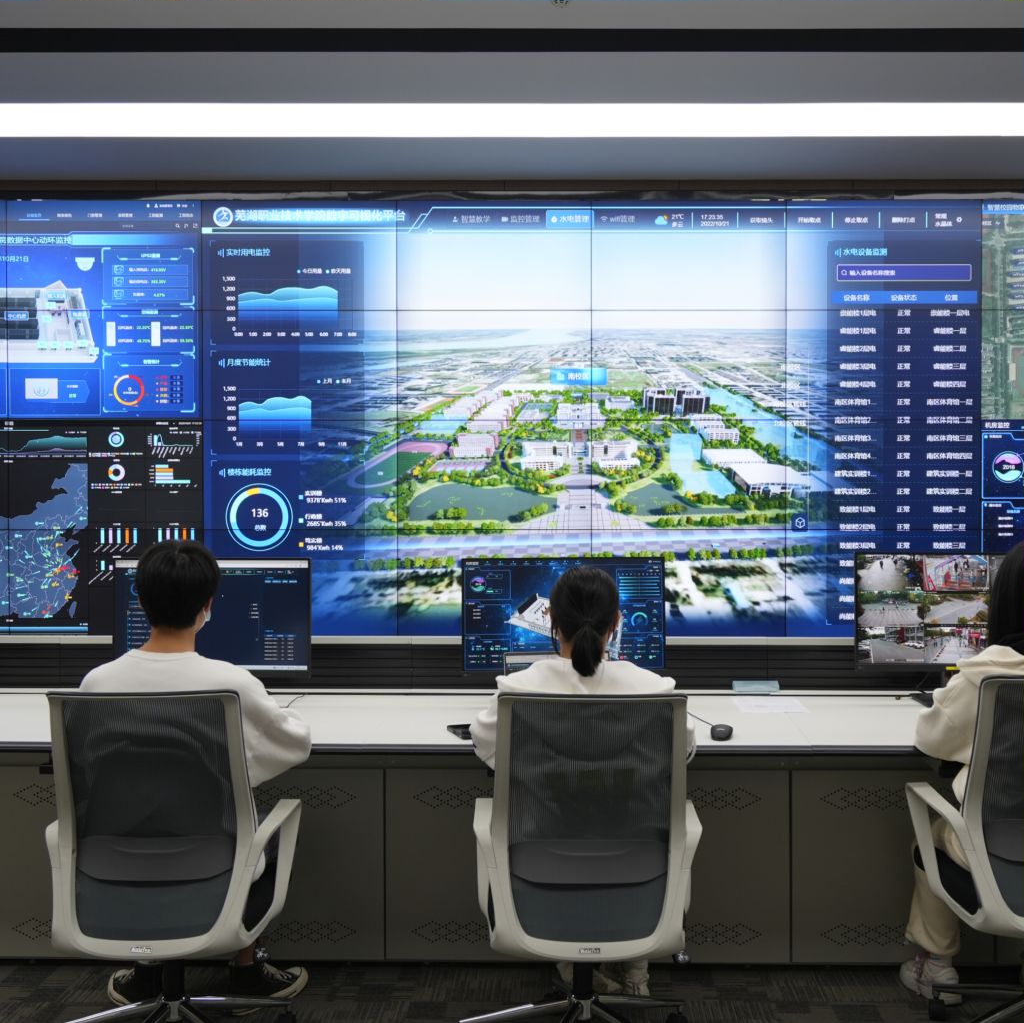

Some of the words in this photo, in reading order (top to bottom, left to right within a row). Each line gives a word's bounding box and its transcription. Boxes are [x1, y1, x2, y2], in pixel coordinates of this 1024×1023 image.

[560, 215, 590, 223] 水电管理
[226, 249, 270, 257] 实时用电监控
[842, 249, 888, 257] 水电设备监测
[226, 359, 271, 367] 月度节能统计
[251, 508, 269, 518] 136
